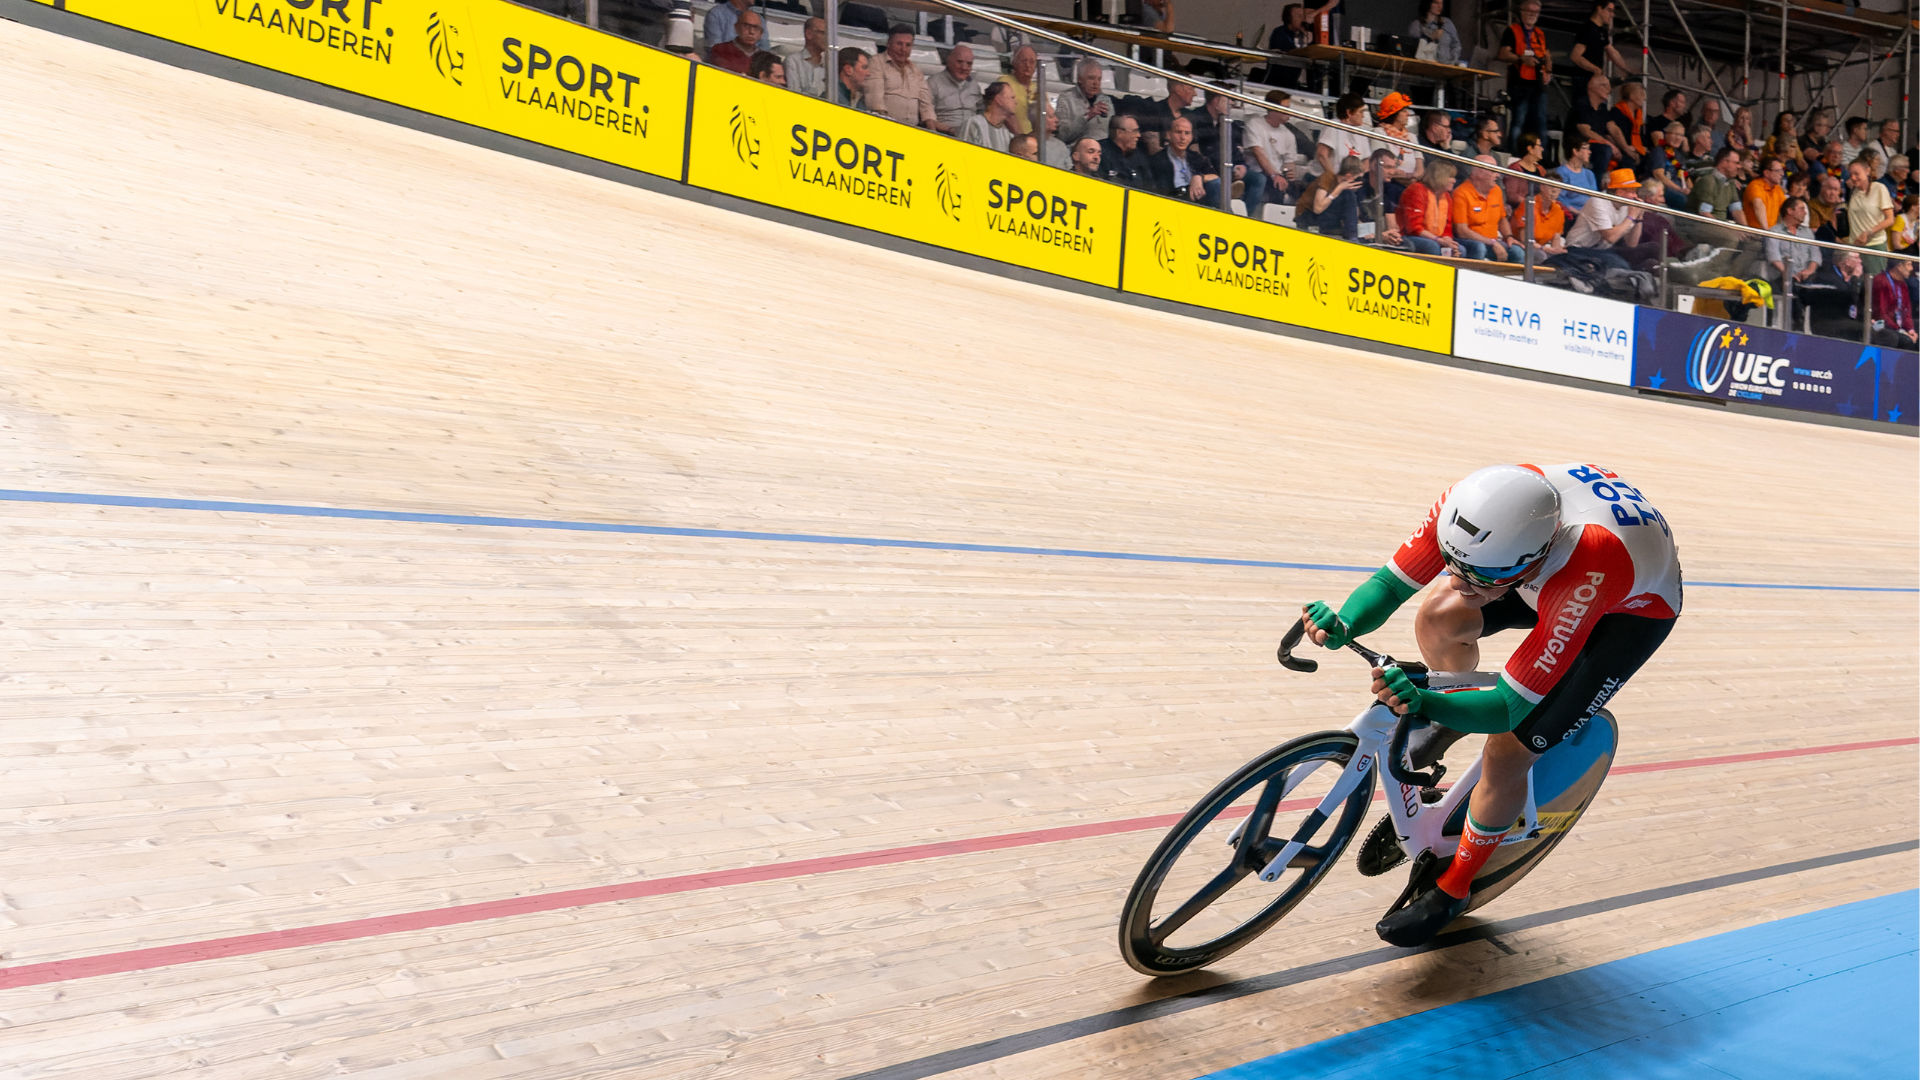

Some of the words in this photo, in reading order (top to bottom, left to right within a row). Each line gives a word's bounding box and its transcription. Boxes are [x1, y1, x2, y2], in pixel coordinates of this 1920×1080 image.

[215, 0, 392, 65] VLAANDEREN
[501, 36, 650, 115] SPORT.
[499, 76, 649, 139] VLAANDEREN
[789, 123, 914, 188] SPORT.
[788, 159, 912, 209] VLAANDEREN
[987, 178, 1095, 234] SPORT.
[985, 211, 1094, 255] VLAANDEREN
[1197, 232, 1291, 280] SPORT.
[1196, 263, 1291, 298] VLAANDEREN
[1347, 266, 1432, 310] SPORT.
[1346, 295, 1431, 327] VLAANDEREN
[1472, 301, 1542, 331] HERVA
[1562, 318, 1628, 347] HERVA
[1473, 326, 1507, 341] visibility
[1508, 333, 1539, 346] matters
[1563, 342, 1596, 357] visibility
[1596, 349, 1625, 361] matters
[1731, 351, 1791, 388] UEC
[1568, 465, 1642, 527] POR
[1532, 571, 1606, 674] PORTUGAL
[1585, 676, 1620, 716] RURAL
